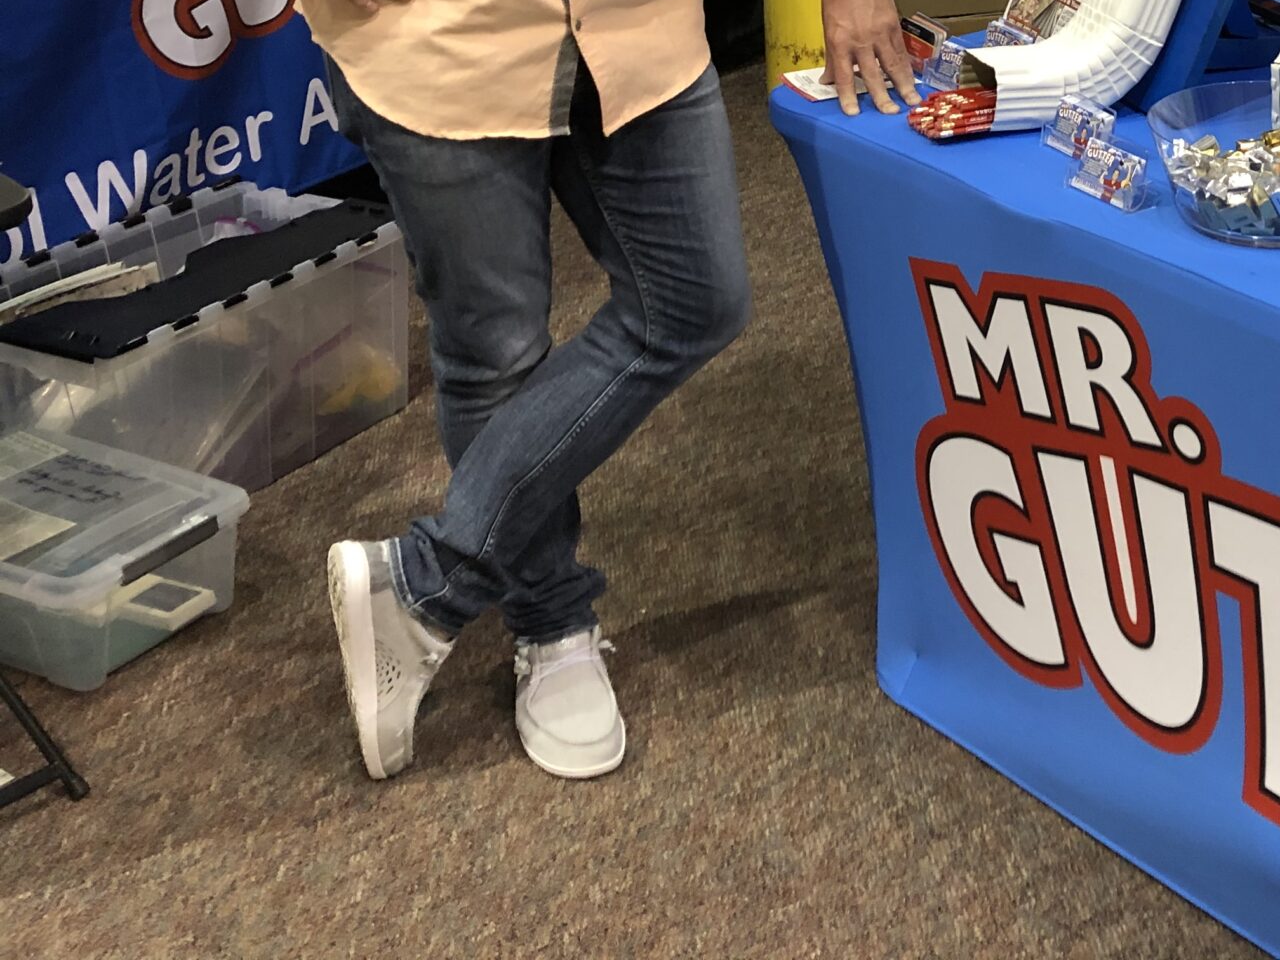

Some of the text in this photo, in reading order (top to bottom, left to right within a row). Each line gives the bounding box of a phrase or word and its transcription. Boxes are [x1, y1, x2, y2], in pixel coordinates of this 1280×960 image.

[1059, 108, 1082, 124] GUTTER
[65, 111, 273, 232] Water
[1087, 148, 1115, 166] GUTTER
[926, 281, 1205, 461] MR.
